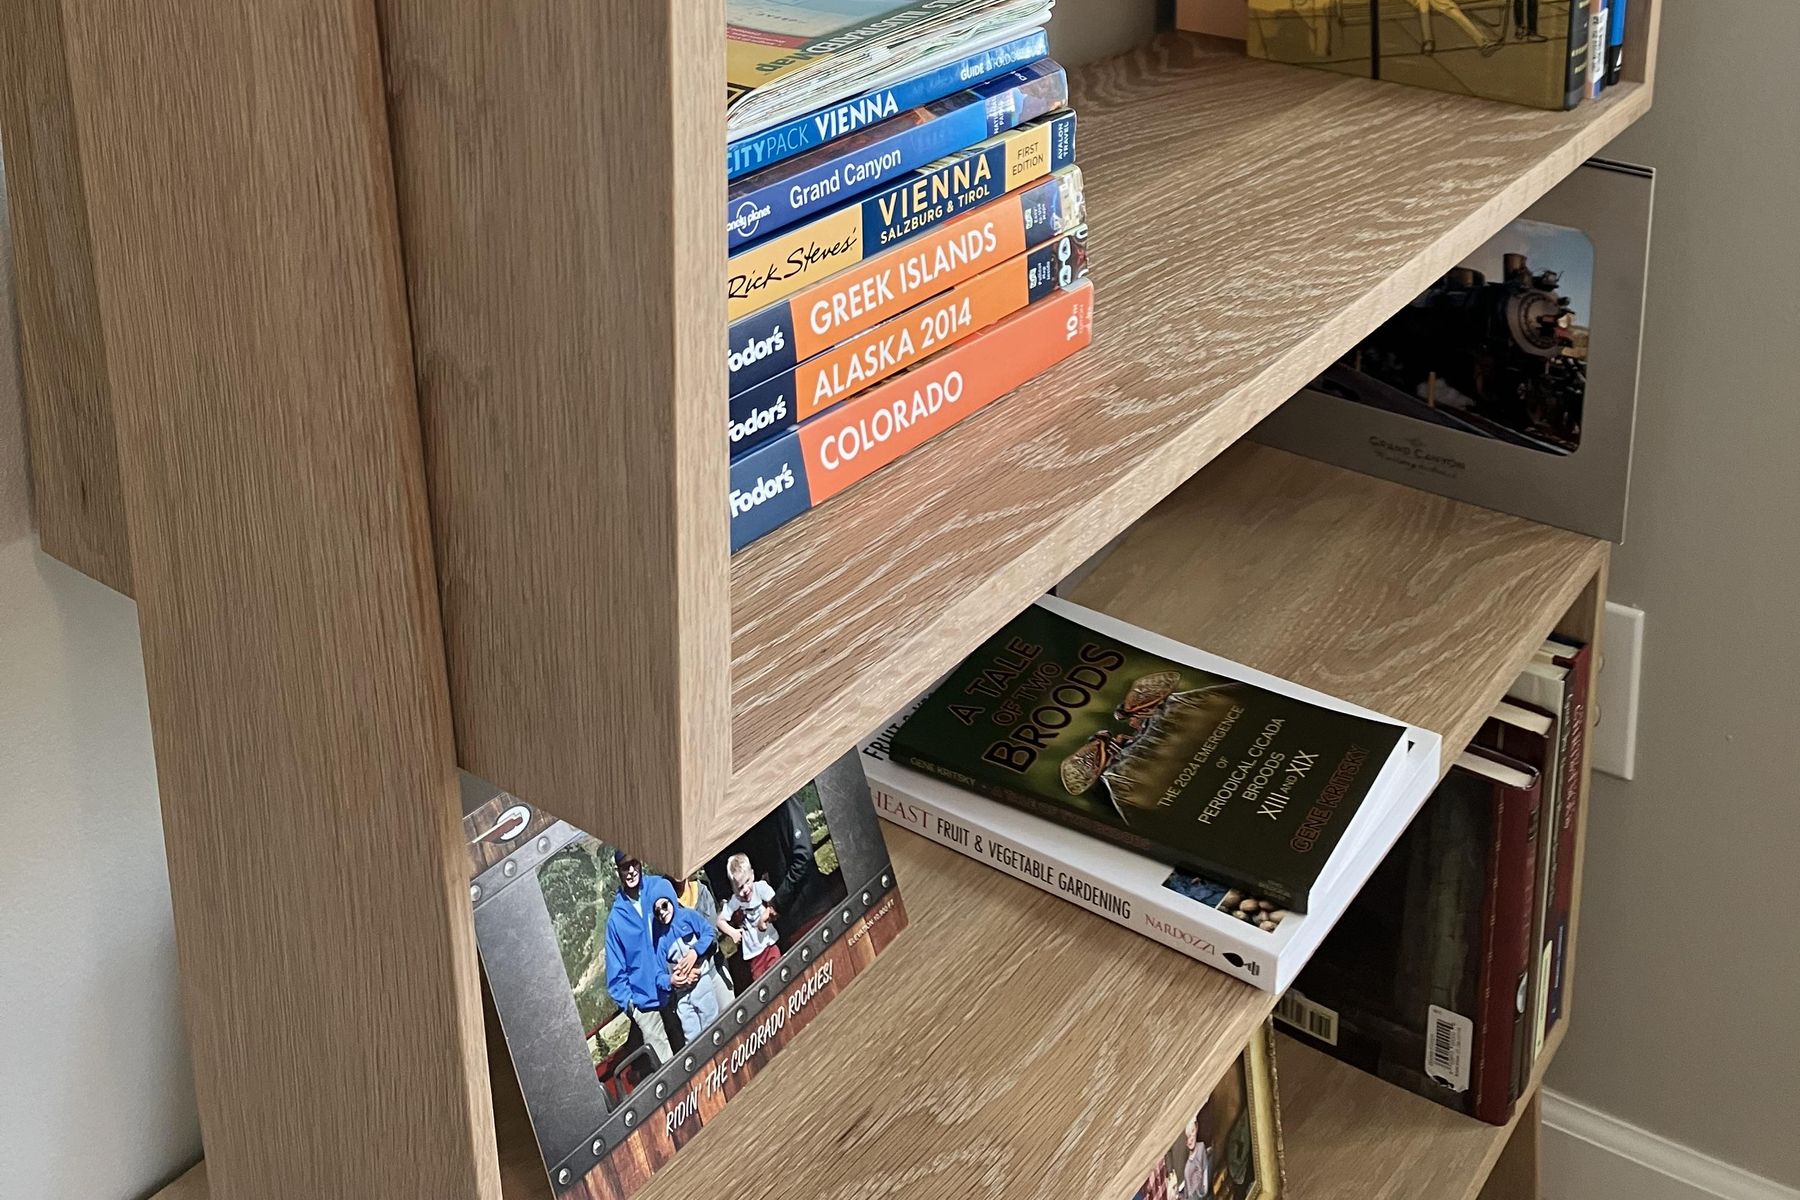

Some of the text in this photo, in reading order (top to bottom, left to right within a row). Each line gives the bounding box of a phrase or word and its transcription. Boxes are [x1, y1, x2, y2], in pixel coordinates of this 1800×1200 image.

[755, 48, 812, 74] Map
[806, 10, 927, 55] ILLUSTRATED
[960, 61, 985, 81] GUIDE
[814, 90, 899, 141] VIENNA
[789, 149, 902, 208] Grand Canyon
[1012, 153, 1044, 176] EDITION
[1017, 141, 1040, 160] FIRST
[726, 203, 771, 233] onely planet
[878, 154, 992, 226] VIENNA
[880, 184, 990, 245] SALZBURG & TIROL
[728, 264, 783, 299] Rick
[728, 222, 997, 372] odor's GREEK ISLANDS
[812, 328, 915, 407] ALASKA
[920, 297, 972, 349] 2014
[728, 462, 795, 519] Fodor's
[819, 370, 963, 471] COLORADO
[946, 635, 1043, 726] A TALE
[981, 641, 1126, 774] BROODS
[991, 662, 1062, 726] OF TWO
[910, 756, 938, 774] GENE
[1157, 703, 1246, 808] THE 2024 EMERGENCE
[1198, 716, 1286, 825] PERIODICAL CICADA
[1215, 756, 1231, 769] OF
[1242, 751, 1286, 801] BROODS
[1256, 750, 1320, 821] XIII AND XIX
[1289, 745, 1371, 853] GENE KRITSKY
[937, 816, 971, 847] FRUIT
[974, 834, 983, 853] &
[989, 840, 1054, 886] VEGETABLE
[1058, 872, 1131, 920] GARDENING
[665, 959, 834, 1137] RIDIN' THE COLORADO ROCKIES!
